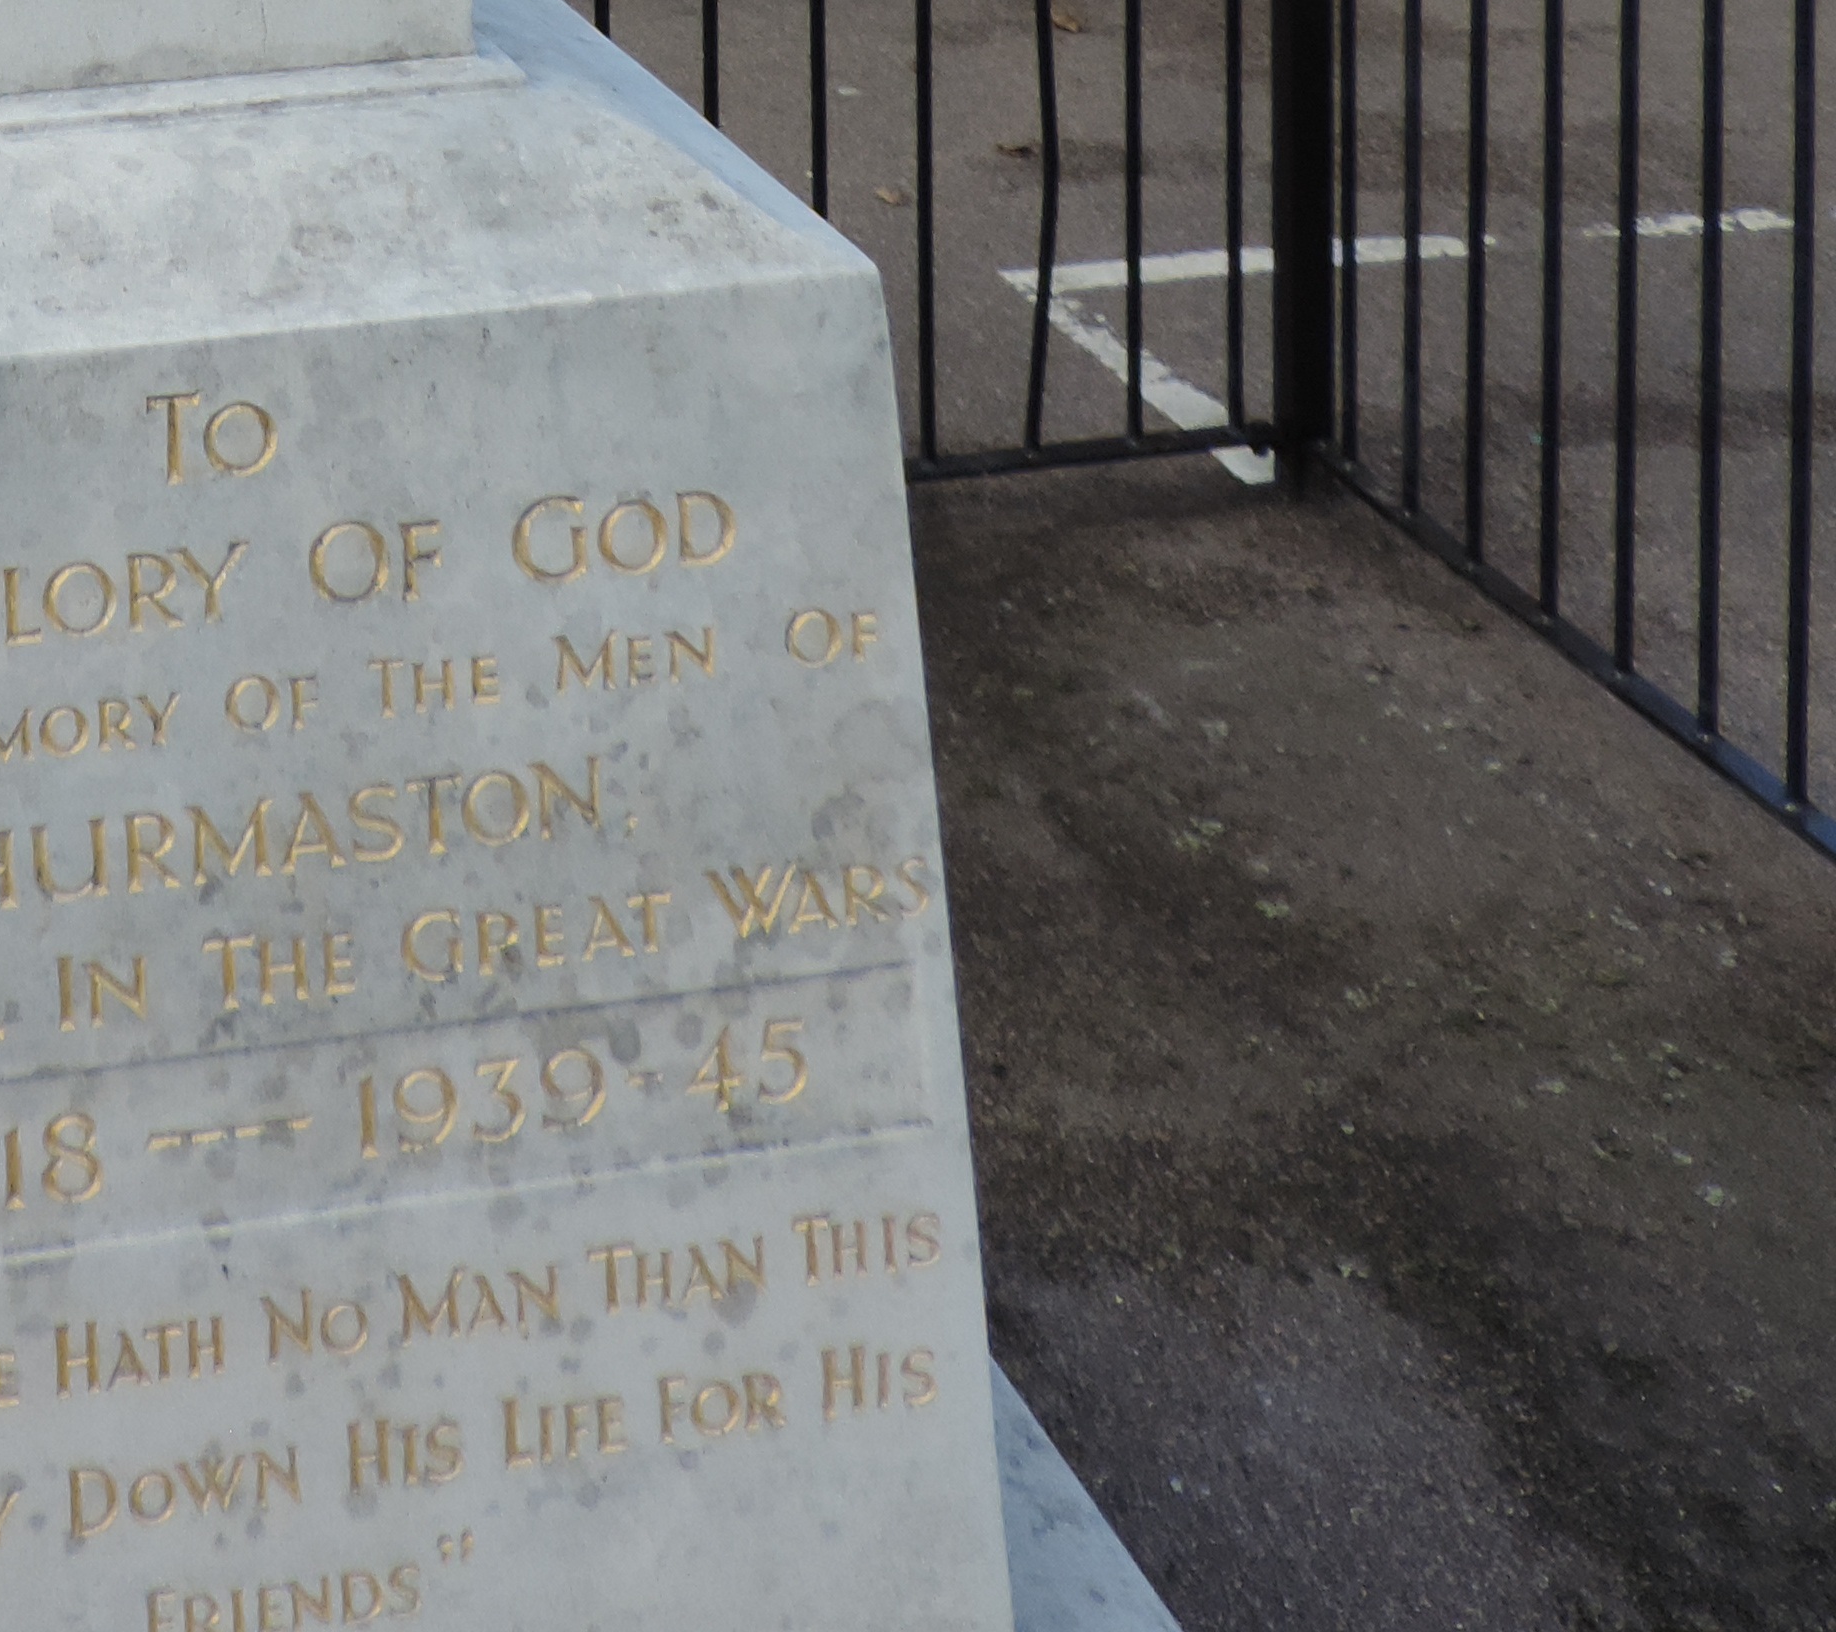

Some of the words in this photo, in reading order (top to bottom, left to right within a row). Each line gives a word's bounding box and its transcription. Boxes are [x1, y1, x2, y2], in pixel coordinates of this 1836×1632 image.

[144, 389, 279, 486] TO
[307, 518, 444, 606] OF
[510, 489, 738, 586] GOD
[224, 671, 320, 734] OF
[366, 654, 503, 721] THE
[550, 625, 718, 695] MEN
[784, 606, 880, 670] OF
[55, 953, 150, 1032] IN
[200, 931, 358, 1013] THE
[399, 891, 674, 984] GREAT
[704, 855, 935, 939] WARS
[356, 1016, 811, 1160] 1939-45
[54, 1314, 228, 1398] HATH
[261, 1288, 369, 1366] NO
[396, 1263, 562, 1348] MAN
[586, 1234, 768, 1316] THAN
[790, 1211, 943, 1289] THIS
[68, 1445, 304, 1540] DOWN
[346, 1418, 465, 1497] HIS
[500, 1394, 628, 1471] LIFE
[656, 1371, 789, 1447] FOR
[819, 1344, 940, 1423] HIS
